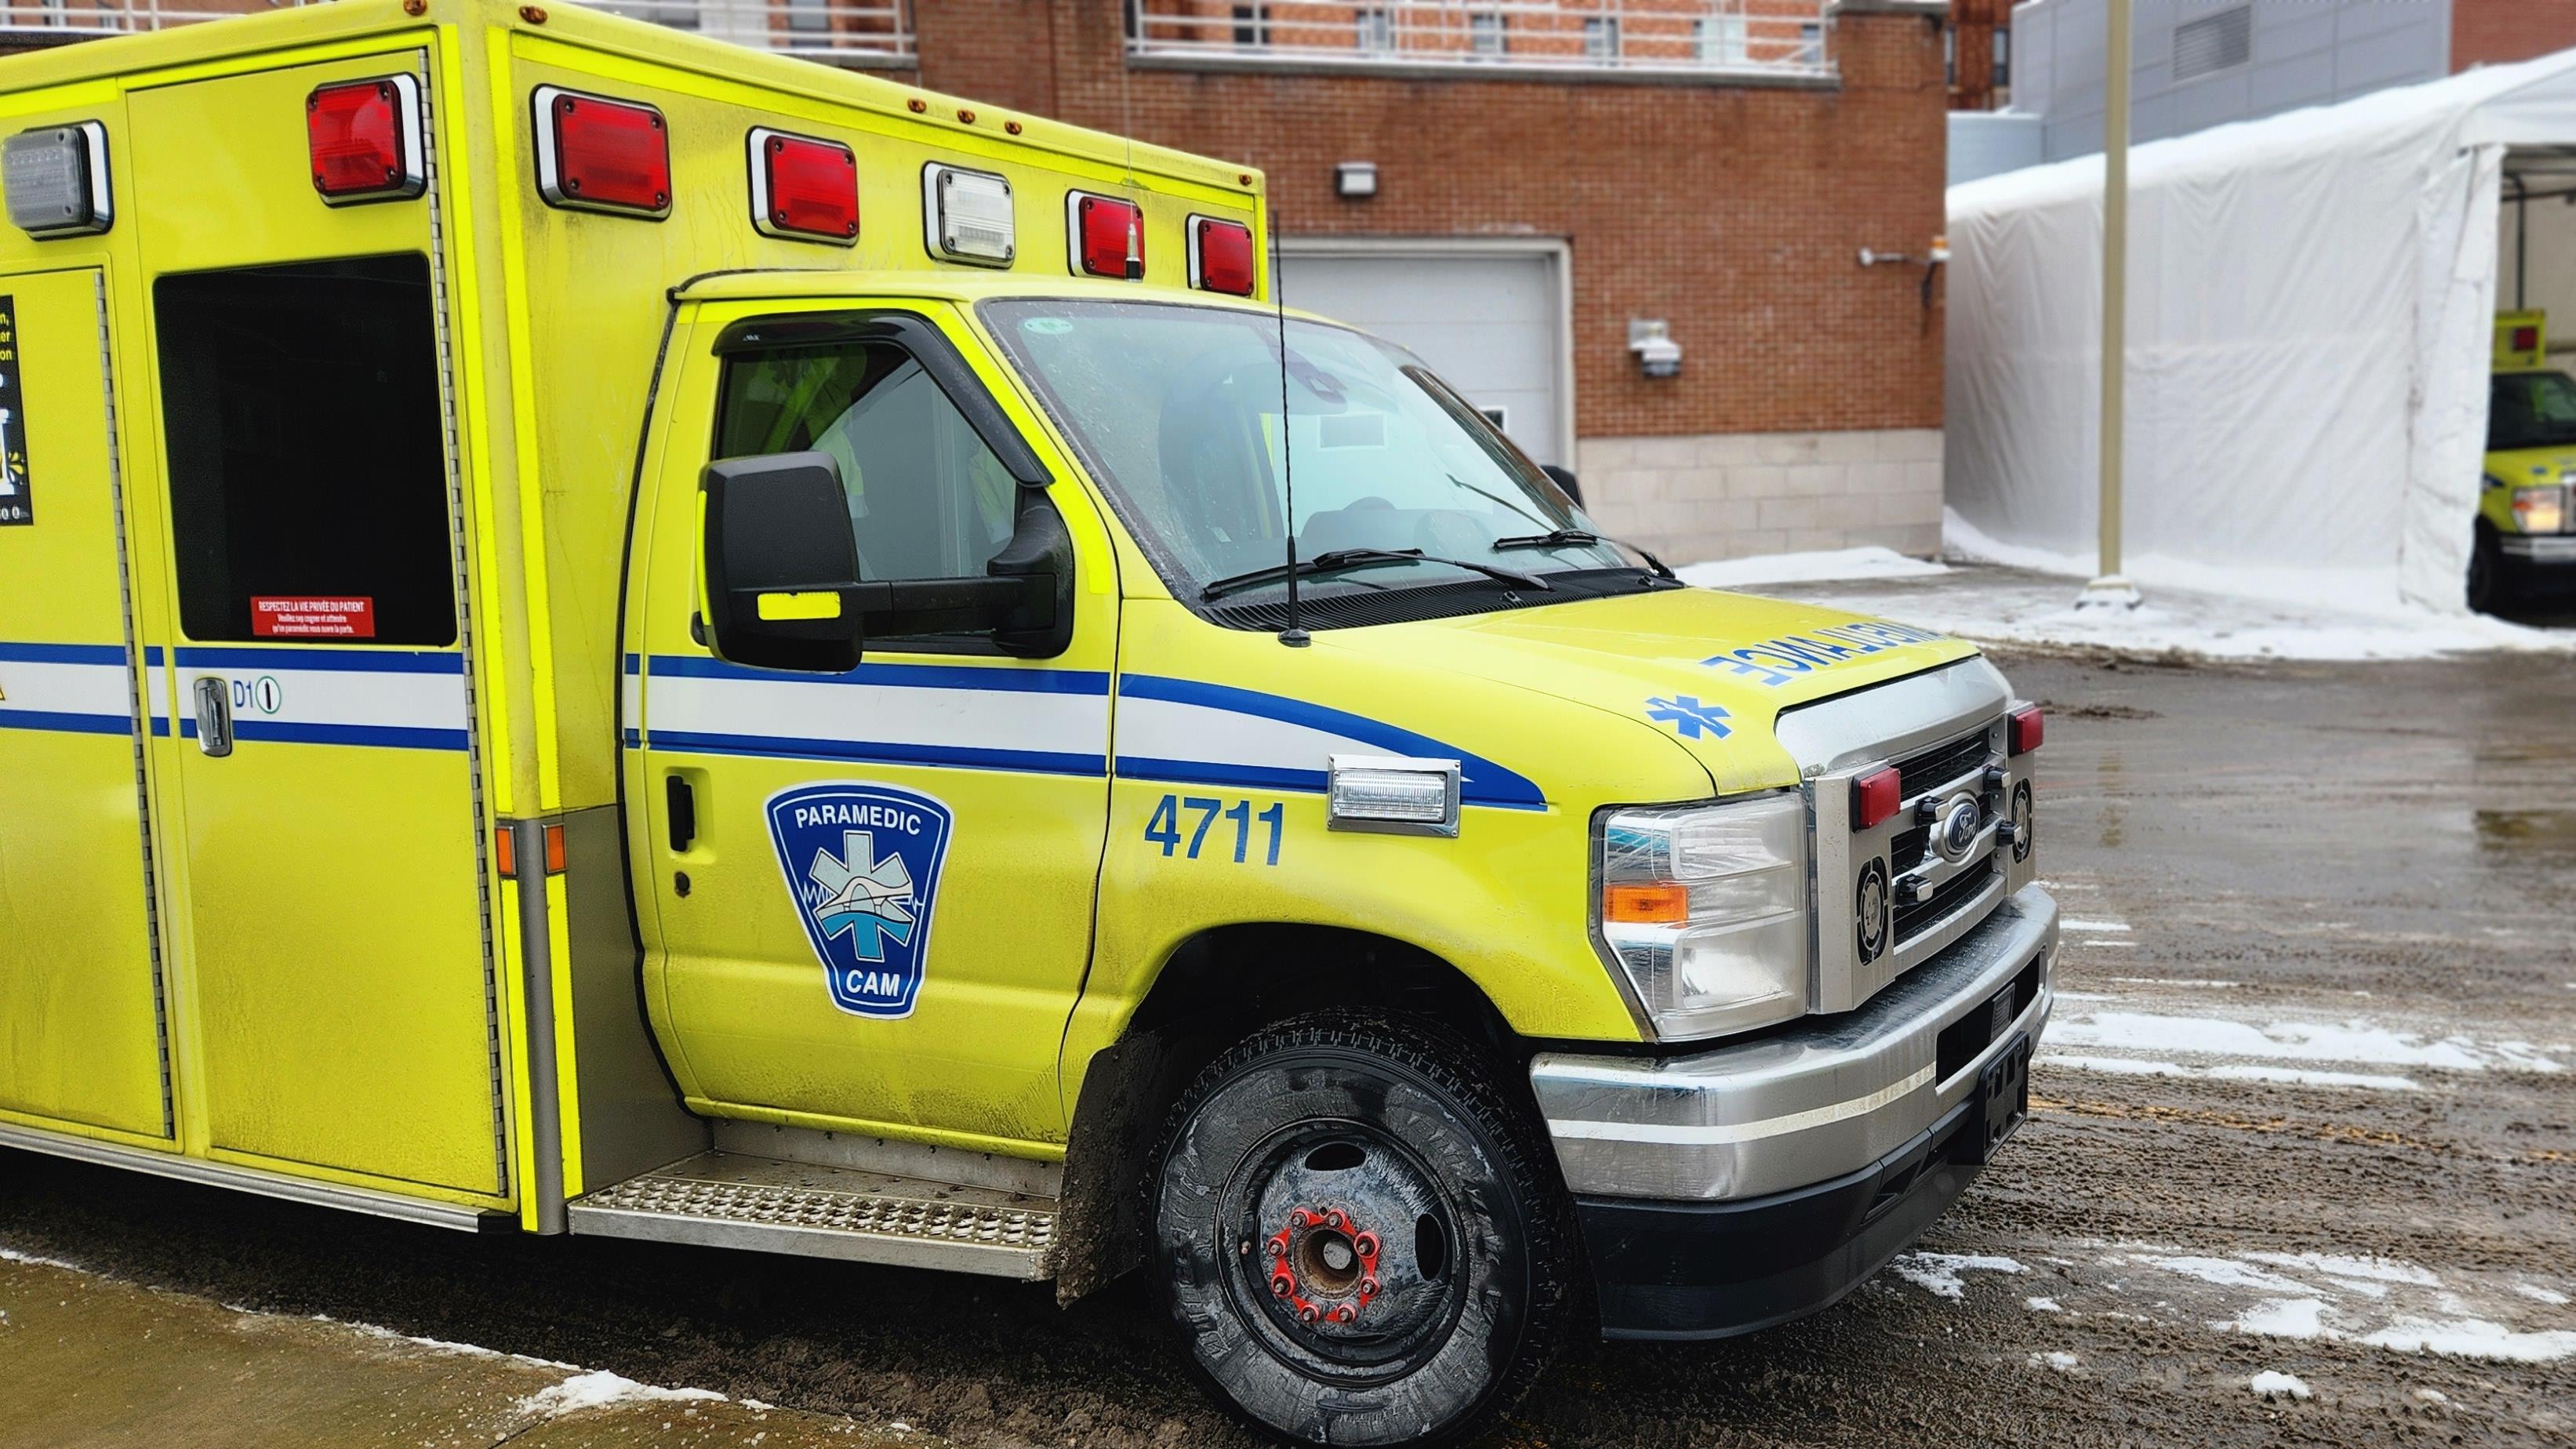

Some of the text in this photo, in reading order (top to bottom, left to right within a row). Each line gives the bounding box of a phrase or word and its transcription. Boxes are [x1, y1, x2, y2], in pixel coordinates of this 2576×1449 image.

[258, 599, 365, 612] RESPECTEZ LA VIE PRIVÉE DU PATIENT
[794, 804, 921, 835] PARAMEDIC
[1144, 794, 1284, 866] 4711
[1958, 812, 1977, 844] Ford
[846, 969, 901, 997] CAM
